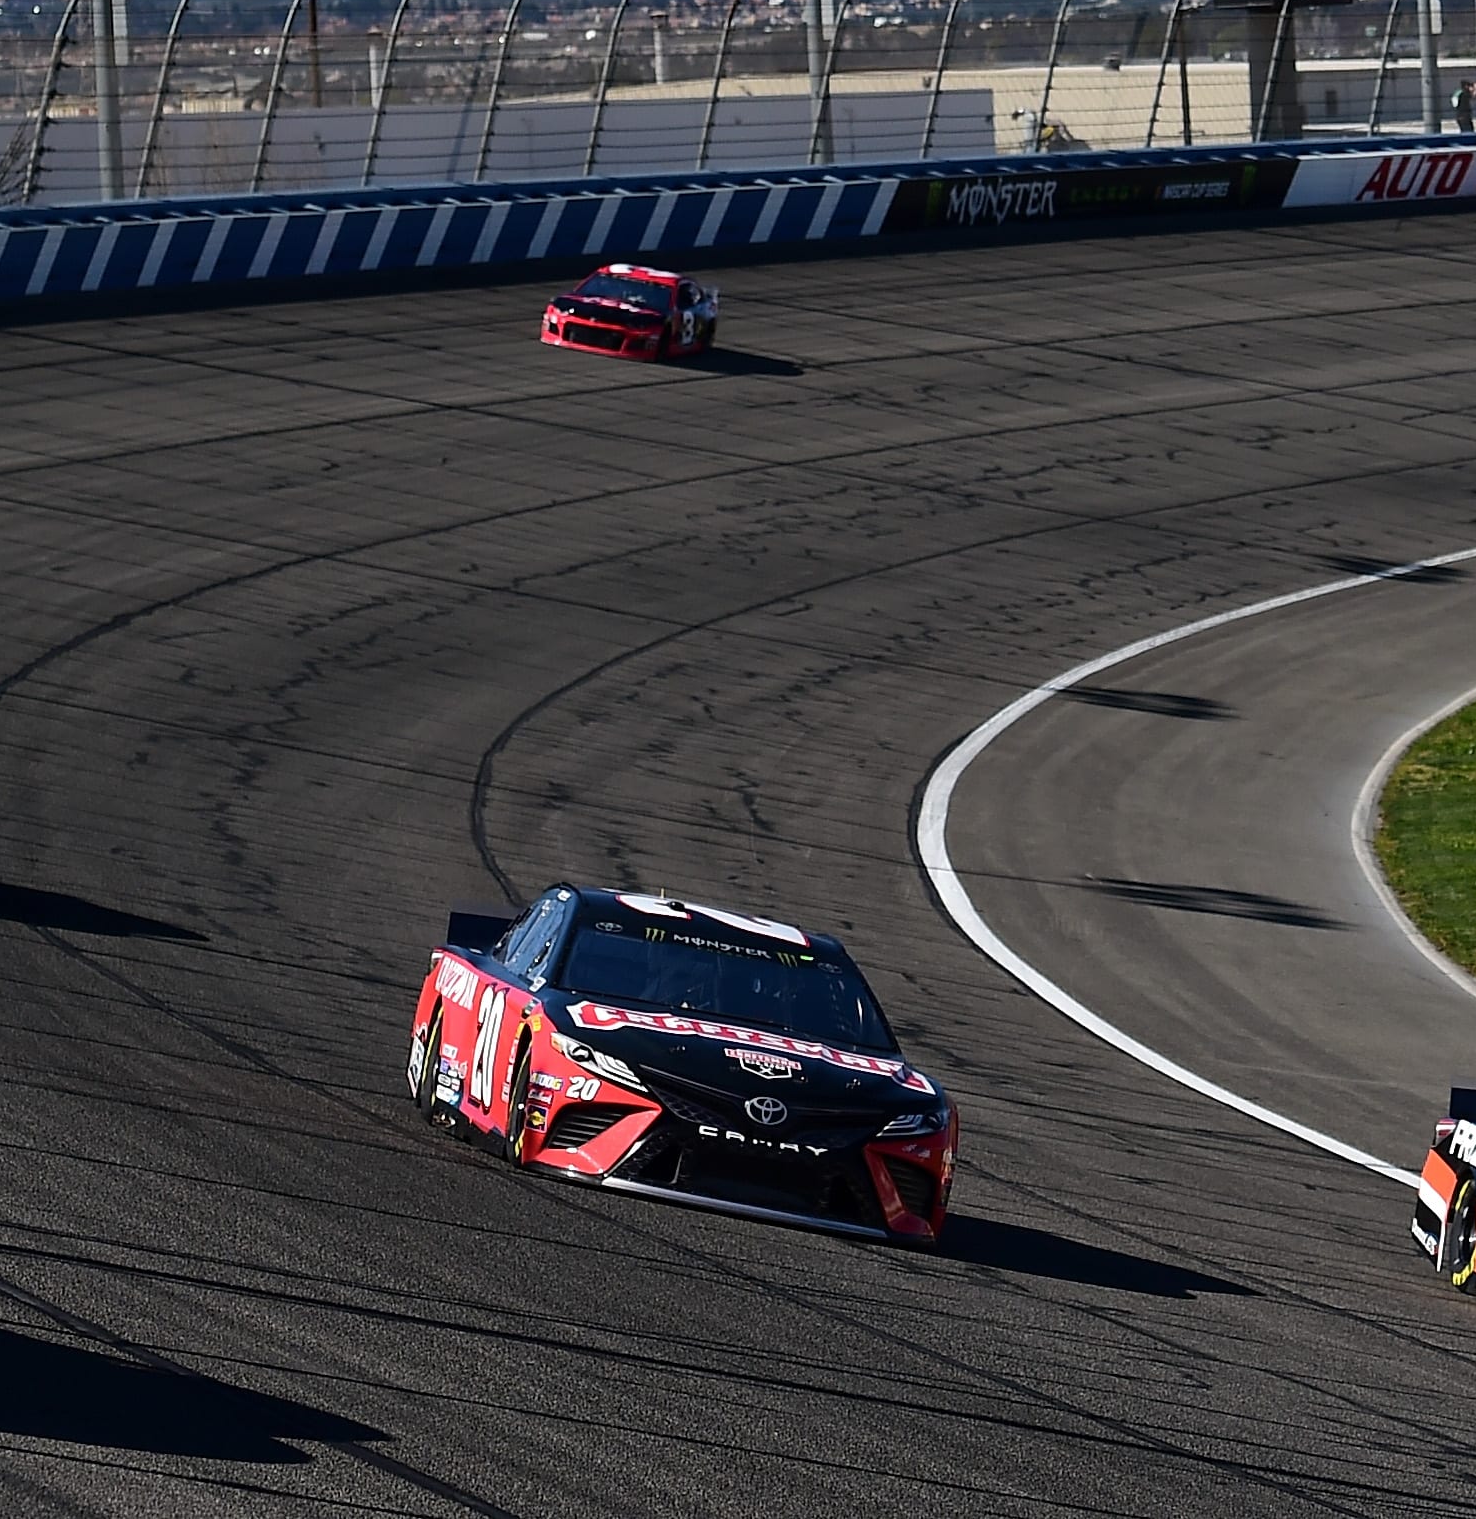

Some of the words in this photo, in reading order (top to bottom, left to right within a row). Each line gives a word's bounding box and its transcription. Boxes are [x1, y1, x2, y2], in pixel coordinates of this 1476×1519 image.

[946, 177, 1058, 225] MONSTER
[1355, 153, 1473, 201] AUTO
[681, 311, 695, 345] 3
[673, 933, 772, 959] MONSTER
[470, 985, 506, 1110] 20
[575, 1000, 937, 1095] CRAFTSMAN
[565, 1076, 602, 1101] 20
